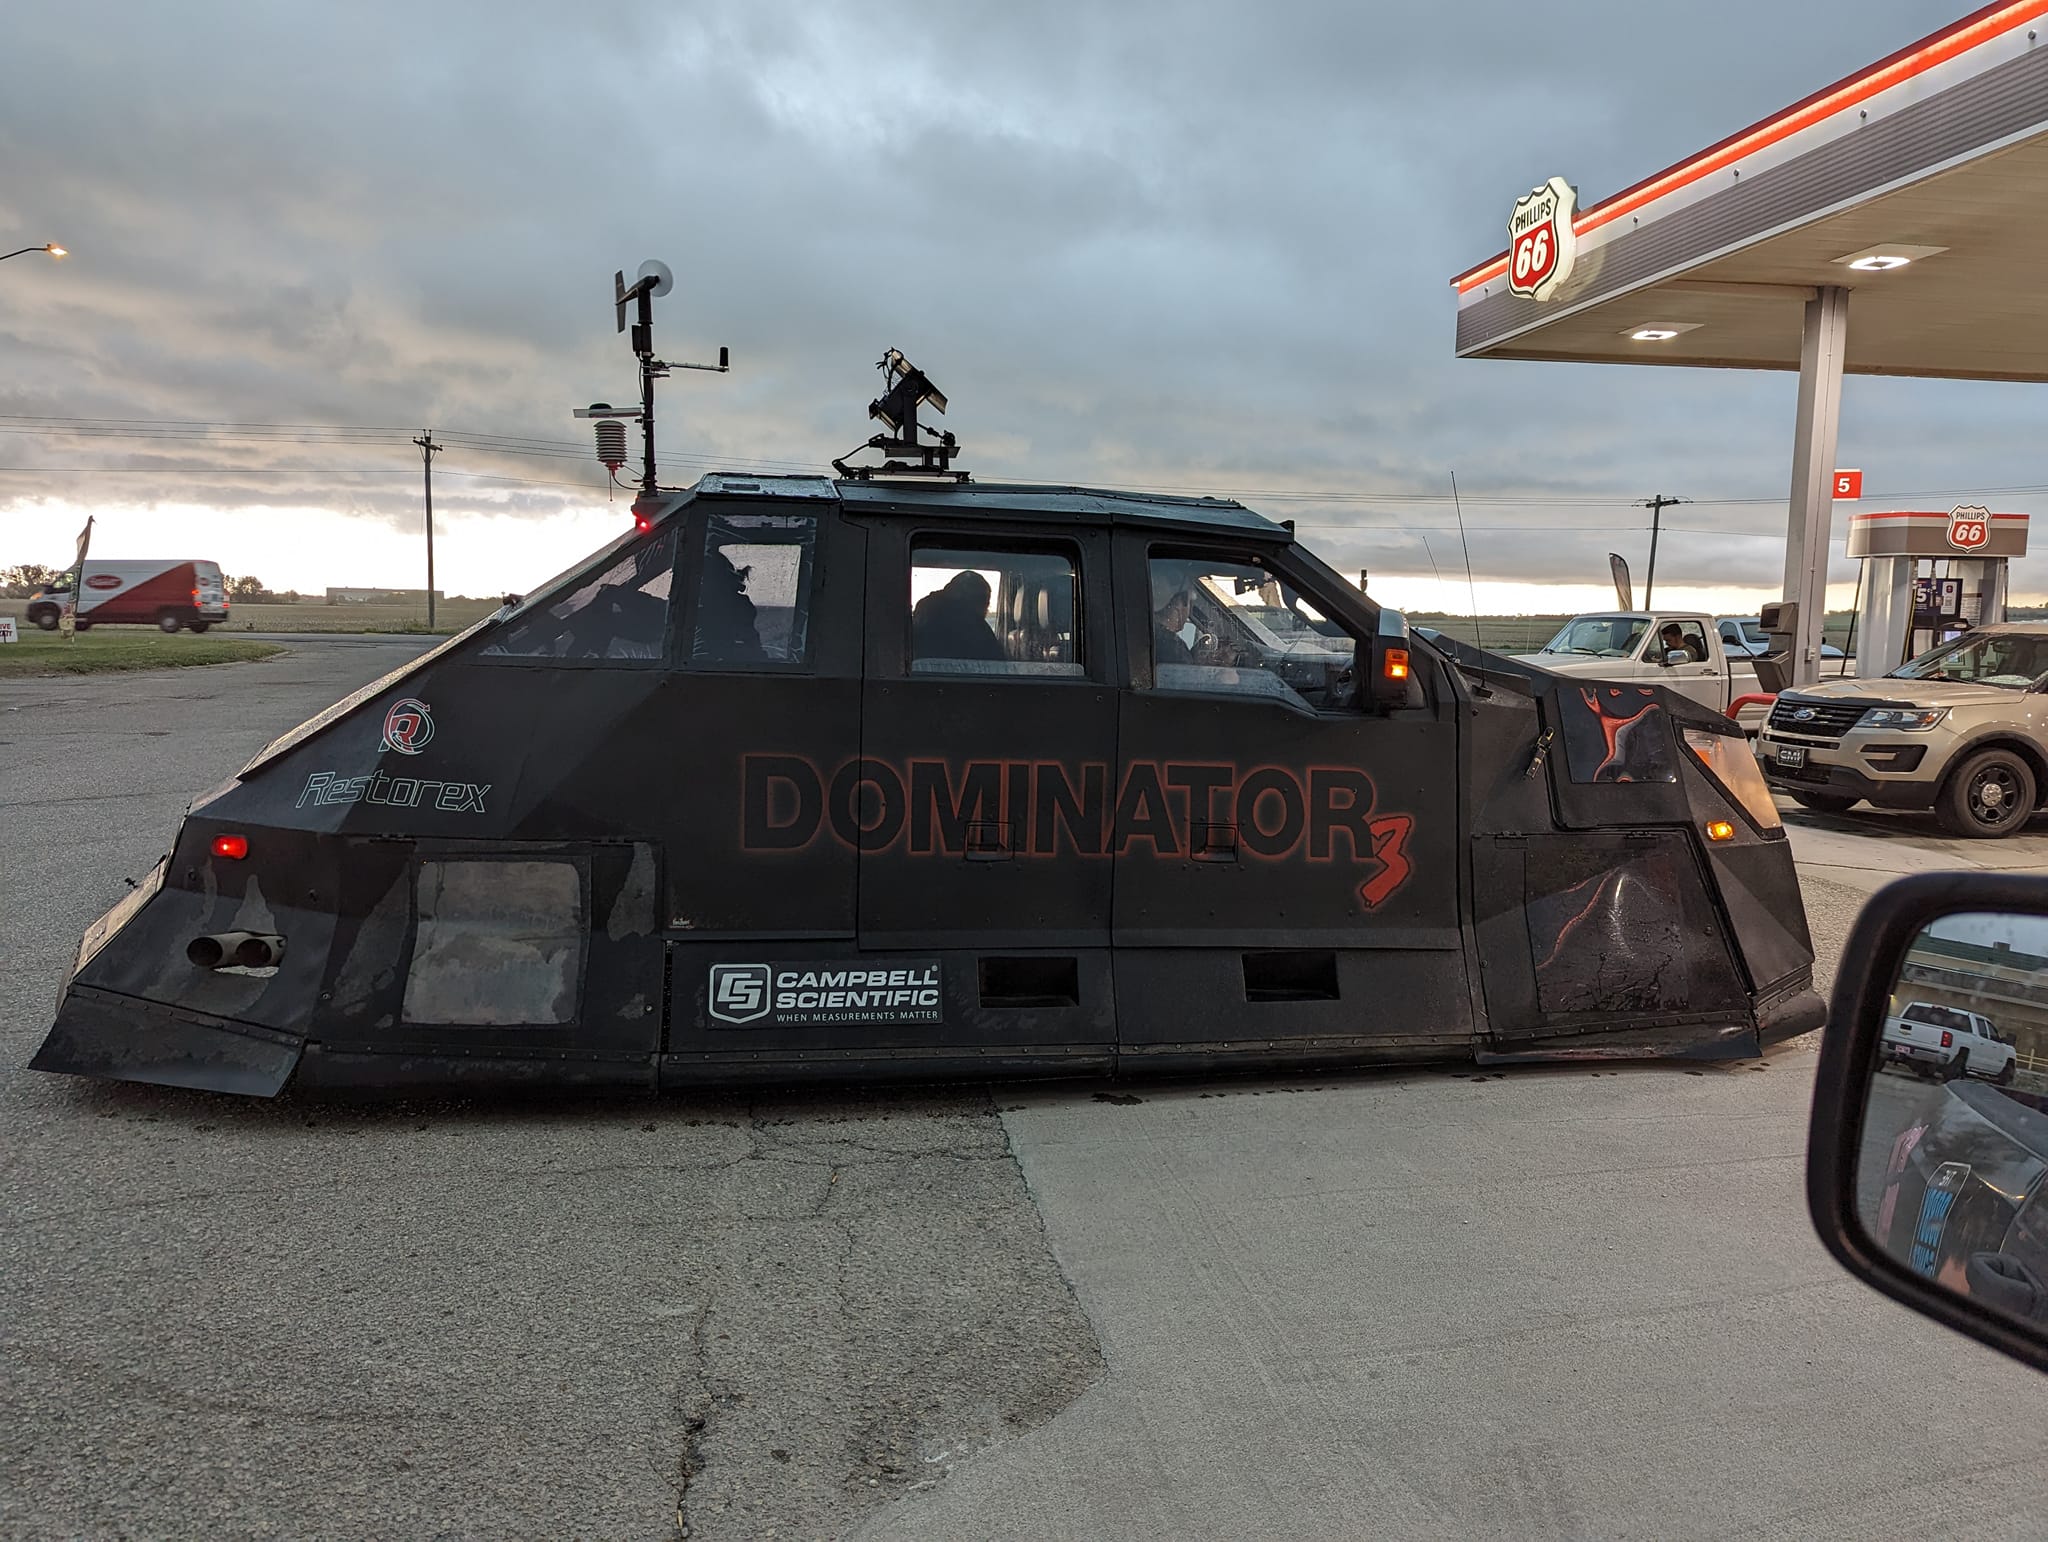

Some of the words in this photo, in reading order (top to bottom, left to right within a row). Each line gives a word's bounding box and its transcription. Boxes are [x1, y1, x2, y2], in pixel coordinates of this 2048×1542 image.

[1515, 198, 1552, 233] PHILLIPS
[1515, 229, 1549, 279] 66
[1838, 477, 1850, 493] 5
[1956, 510, 1985, 521] PHILLIPS
[1955, 524, 1982, 541] 66
[295, 768, 492, 813] Restorex
[742, 752, 1378, 862] DOMINATOR
[1358, 814, 1412, 909] 3
[775, 989, 939, 1009] SCIENTIFIC
[776, 1013, 808, 1022] WHEN
[812, 1011, 895, 1021] MEASUREMENTS
[900, 1010, 938, 1020] MATTER
